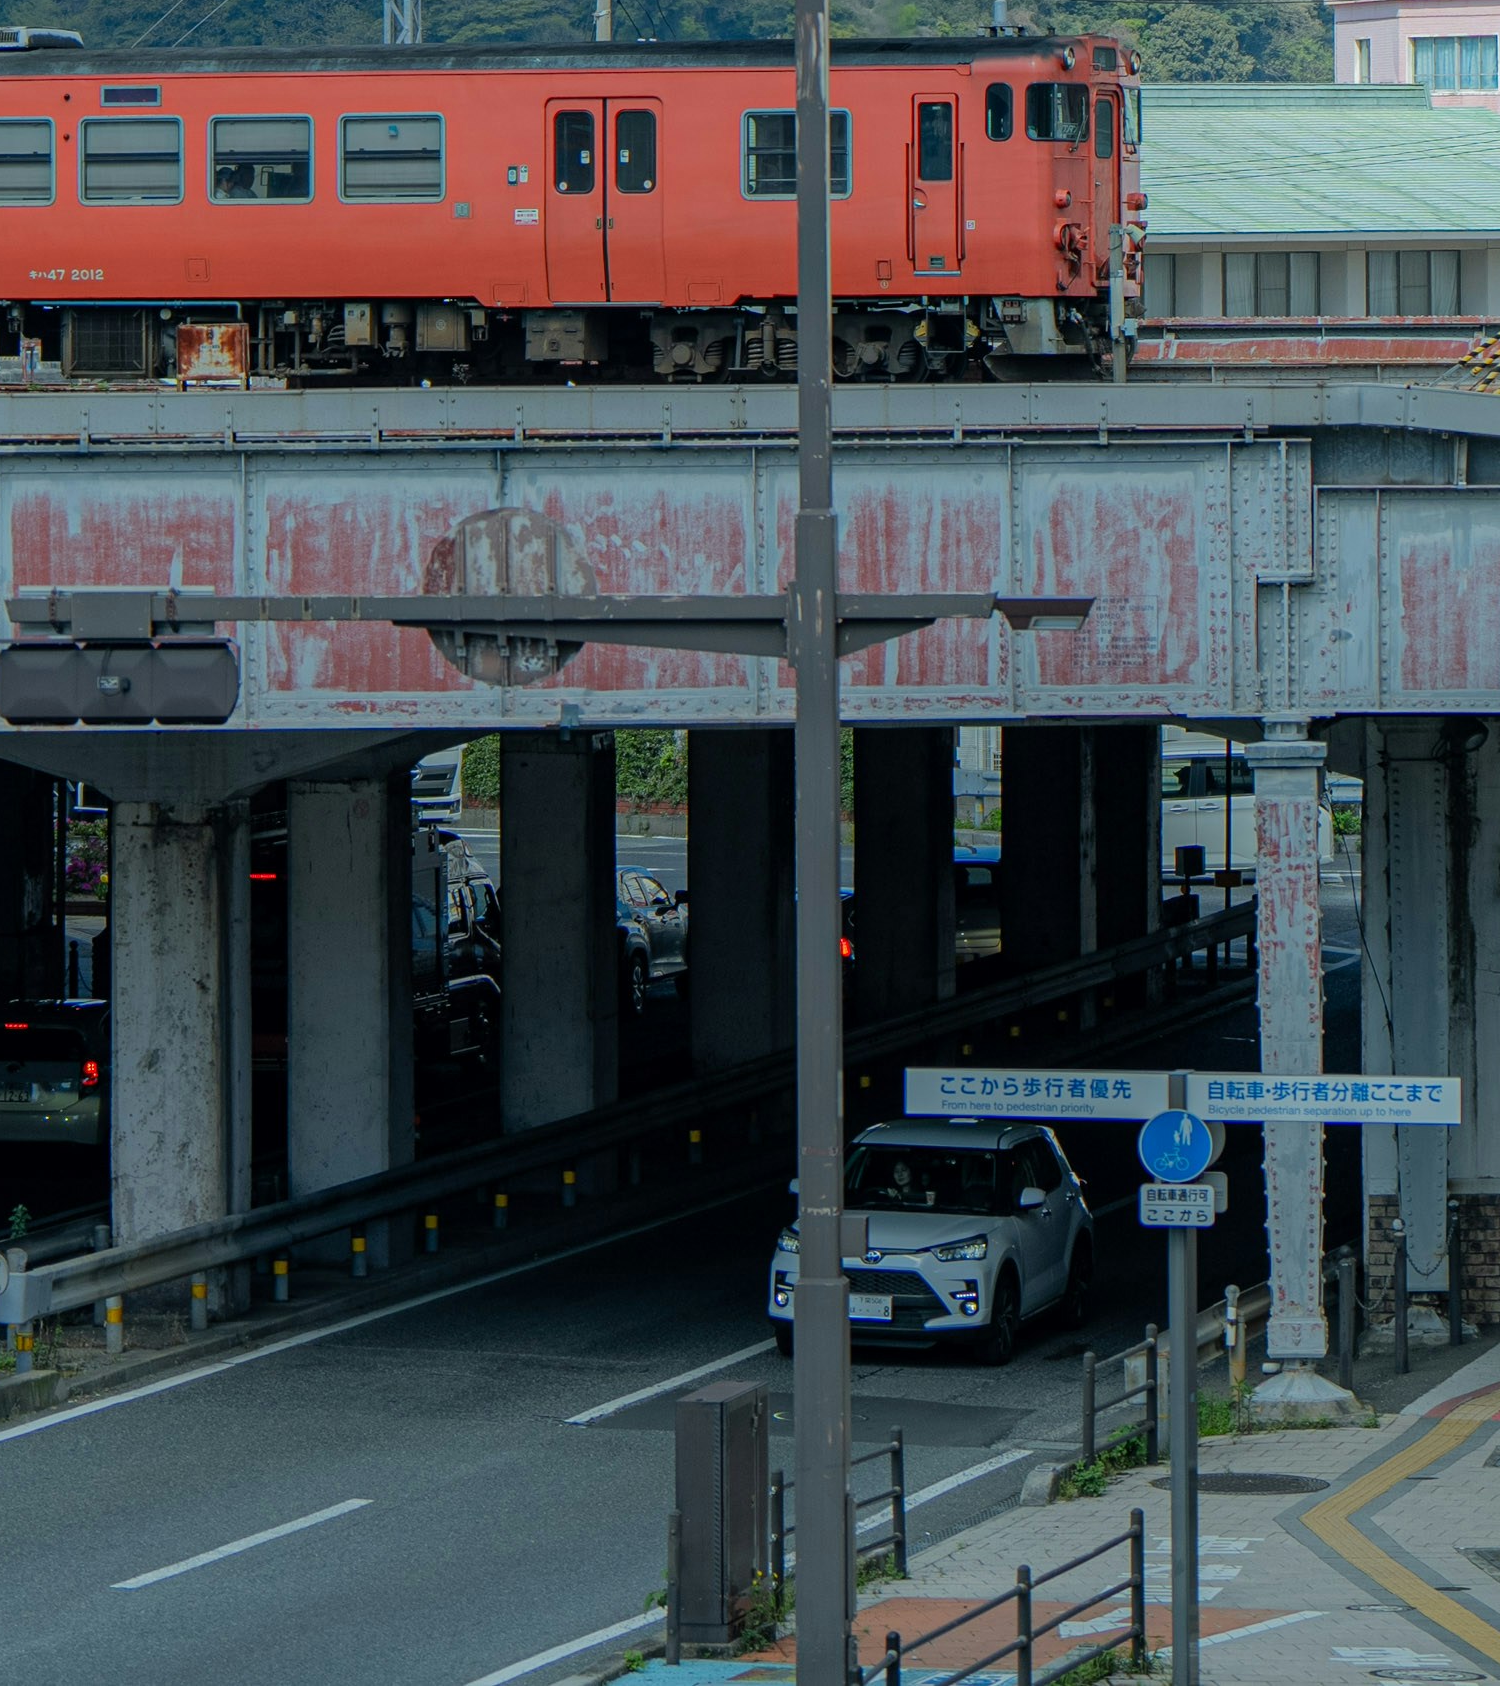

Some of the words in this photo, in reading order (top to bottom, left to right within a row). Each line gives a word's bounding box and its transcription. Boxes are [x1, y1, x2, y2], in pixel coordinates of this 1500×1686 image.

[29, 269, 65, 280] キハ47
[71, 269, 104, 280] 2012
[940, 1076, 1132, 1099] ここから歩行者優先
[941, 1100, 967, 1110] From
[969, 1100, 991, 1111] here
[993, 1102, 1004, 1111] to
[1006, 1101, 1058, 1114] pedestrian
[1060, 1104, 1095, 1114] priority
[1208, 1104, 1245, 1116] Bicycle
[1247, 1106, 1301, 1117] pedestrian
[1303, 1107, 1356, 1118] separation
[1359, 1108, 1373, 1118] up
[1375, 1108, 1386, 1117] to
[1388, 1107, 1412, 1117] here
[1146, 1188, 1209, 1202] 自転車通行可
[1146, 1209, 1209, 1222] ここから
